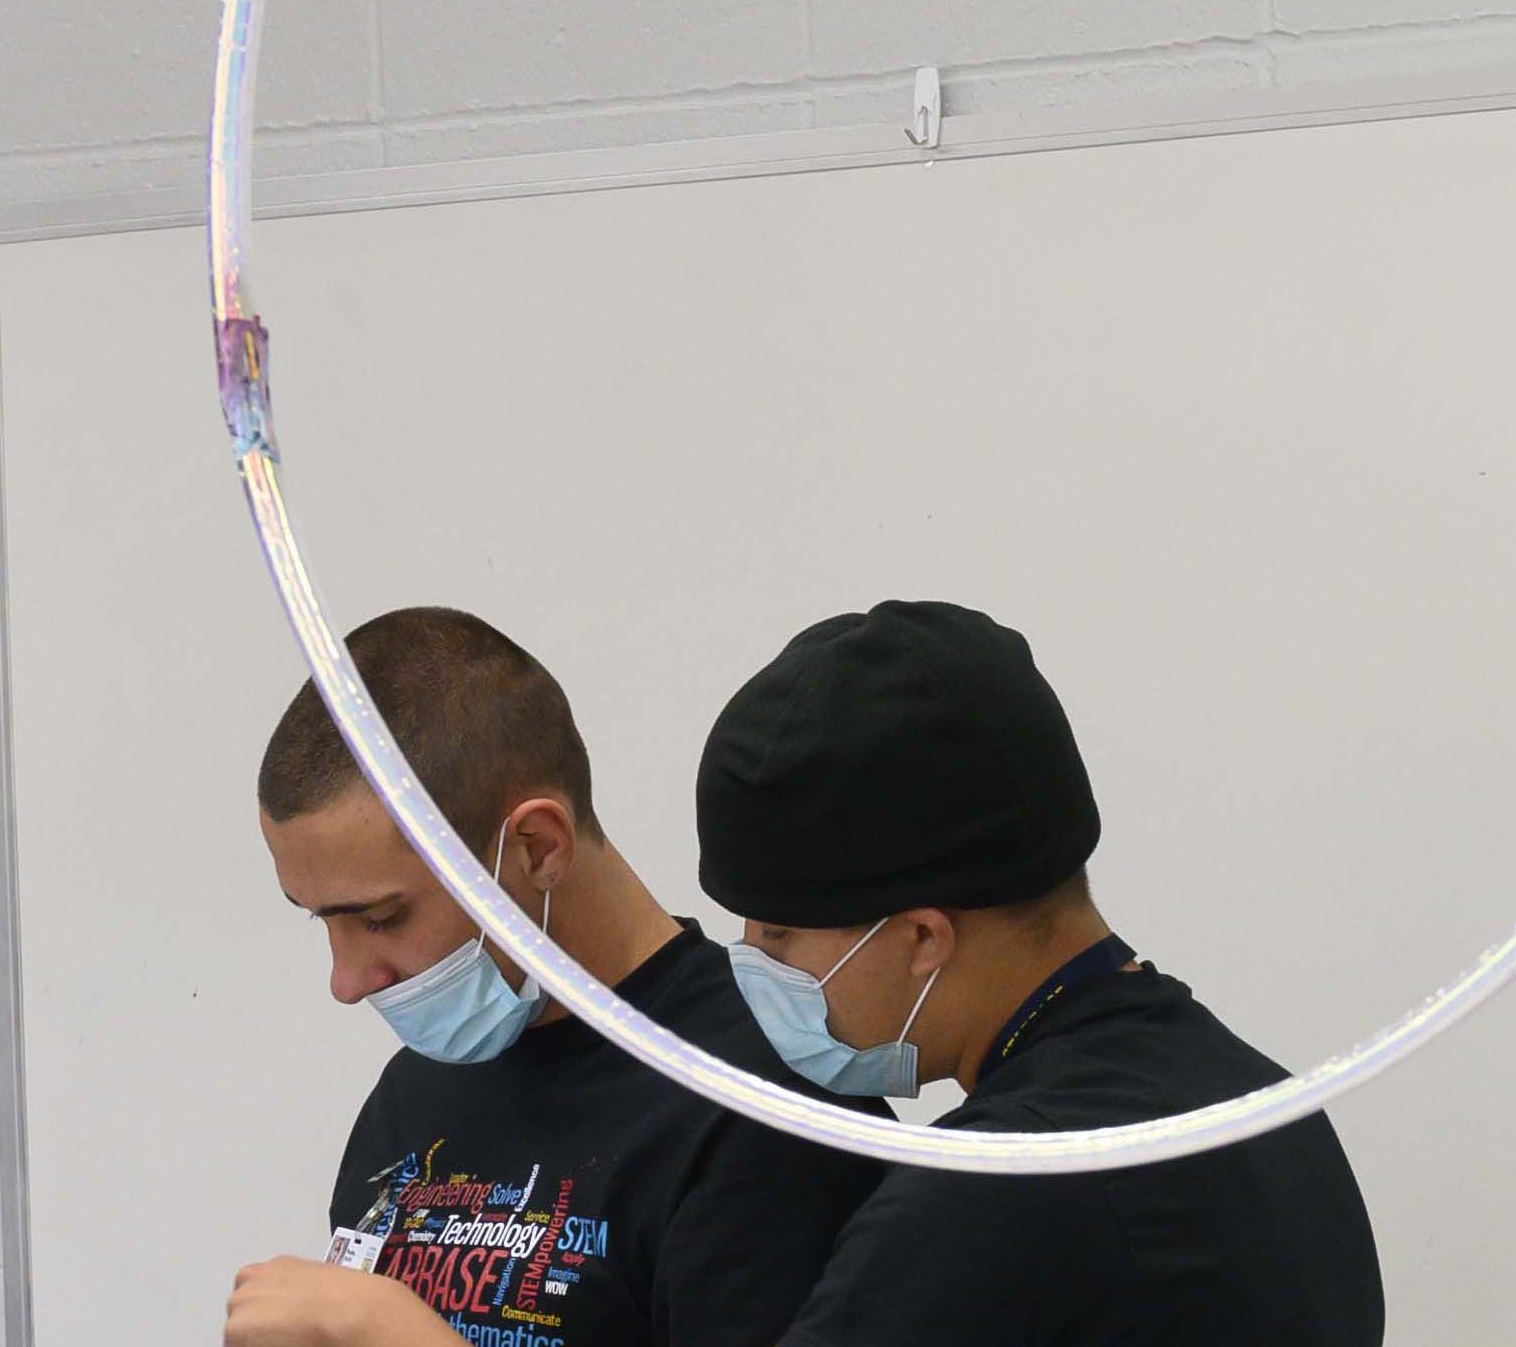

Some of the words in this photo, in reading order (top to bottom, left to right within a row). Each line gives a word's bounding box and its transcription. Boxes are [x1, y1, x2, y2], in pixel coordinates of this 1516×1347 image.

[398, 1174, 493, 1215] Engineering
[488, 1183, 521, 1205] Solve
[437, 1213, 546, 1258] Technology
[545, 1280, 568, 1295] WOW
[501, 1305, 562, 1327] Communicate
